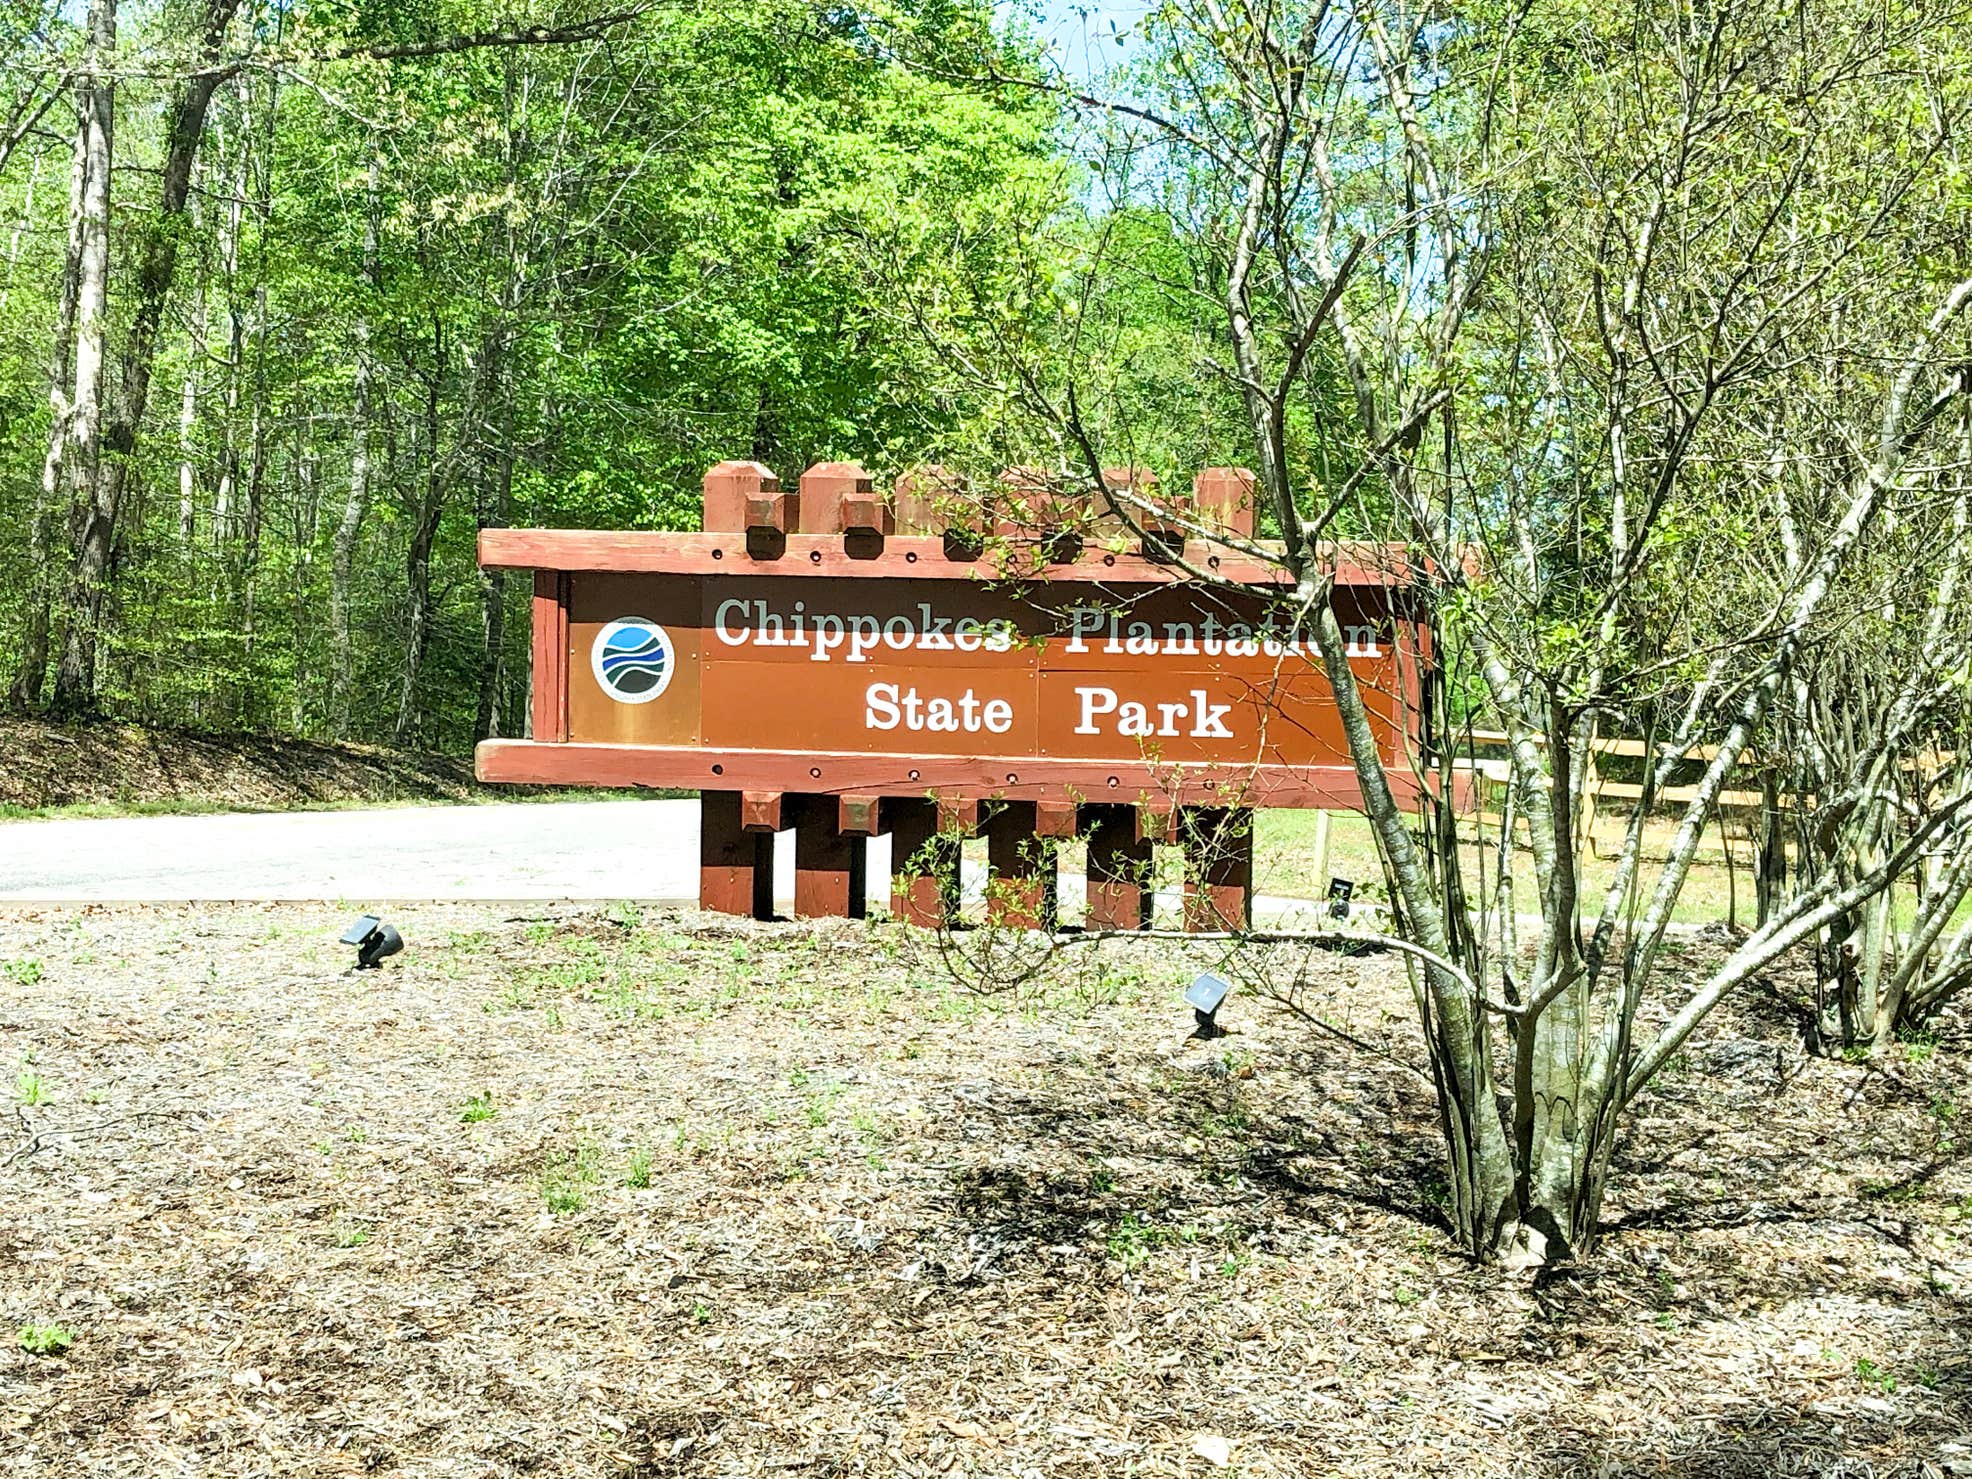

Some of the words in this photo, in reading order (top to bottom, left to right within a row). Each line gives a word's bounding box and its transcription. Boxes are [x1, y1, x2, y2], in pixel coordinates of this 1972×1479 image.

[714, 598, 1012, 662] Chippokes
[865, 682, 1013, 733] State
[1074, 687, 1234, 738] Park
